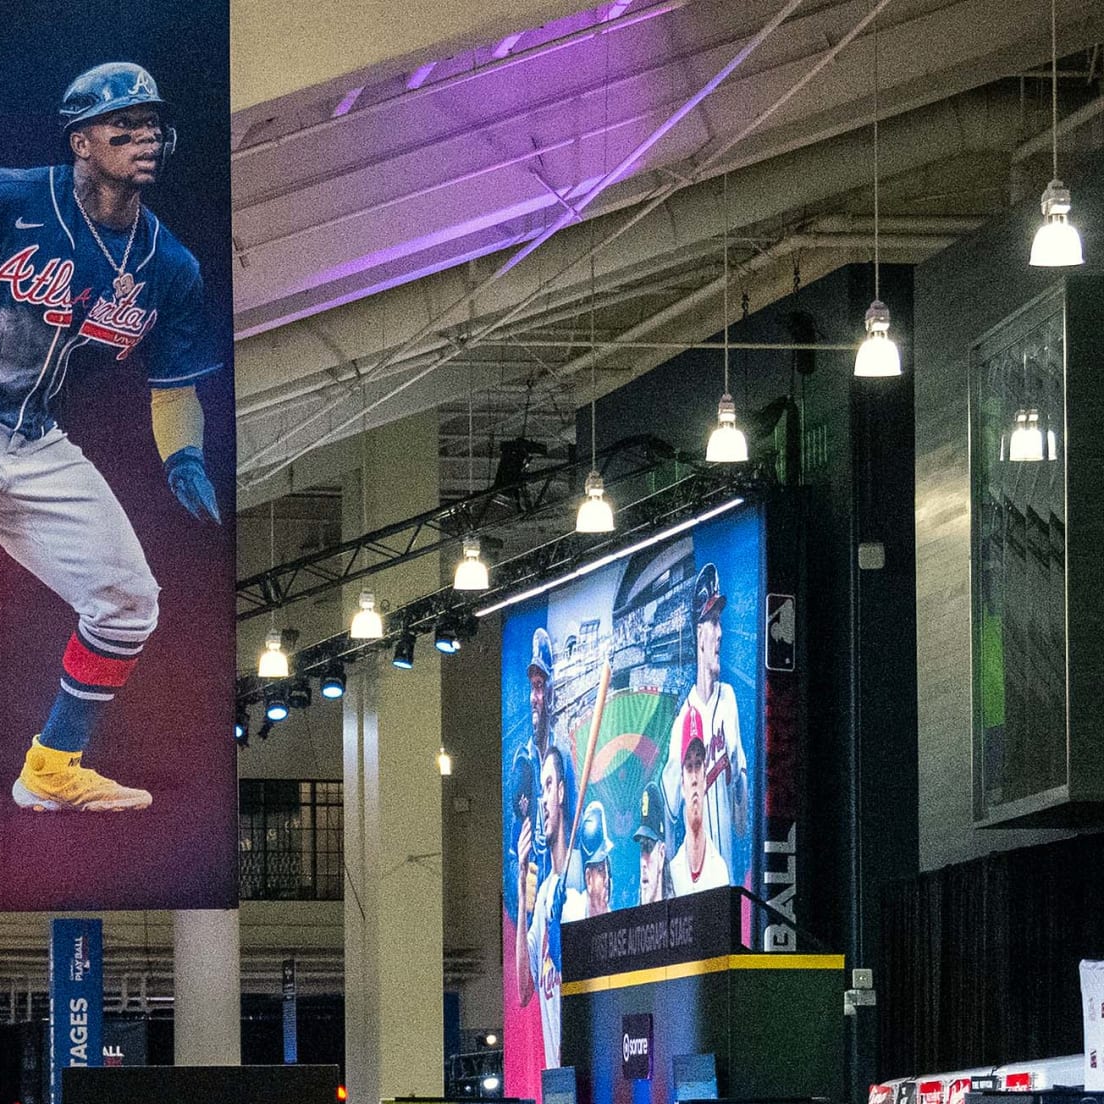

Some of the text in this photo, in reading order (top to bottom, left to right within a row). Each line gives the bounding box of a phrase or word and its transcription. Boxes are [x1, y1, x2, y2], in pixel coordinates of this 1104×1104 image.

[764, 822, 796, 952] BALL
[627, 919, 668, 955] AUTOGRAPH
[669, 915, 694, 948] STAGE
[629, 1038, 648, 1055] sorare
